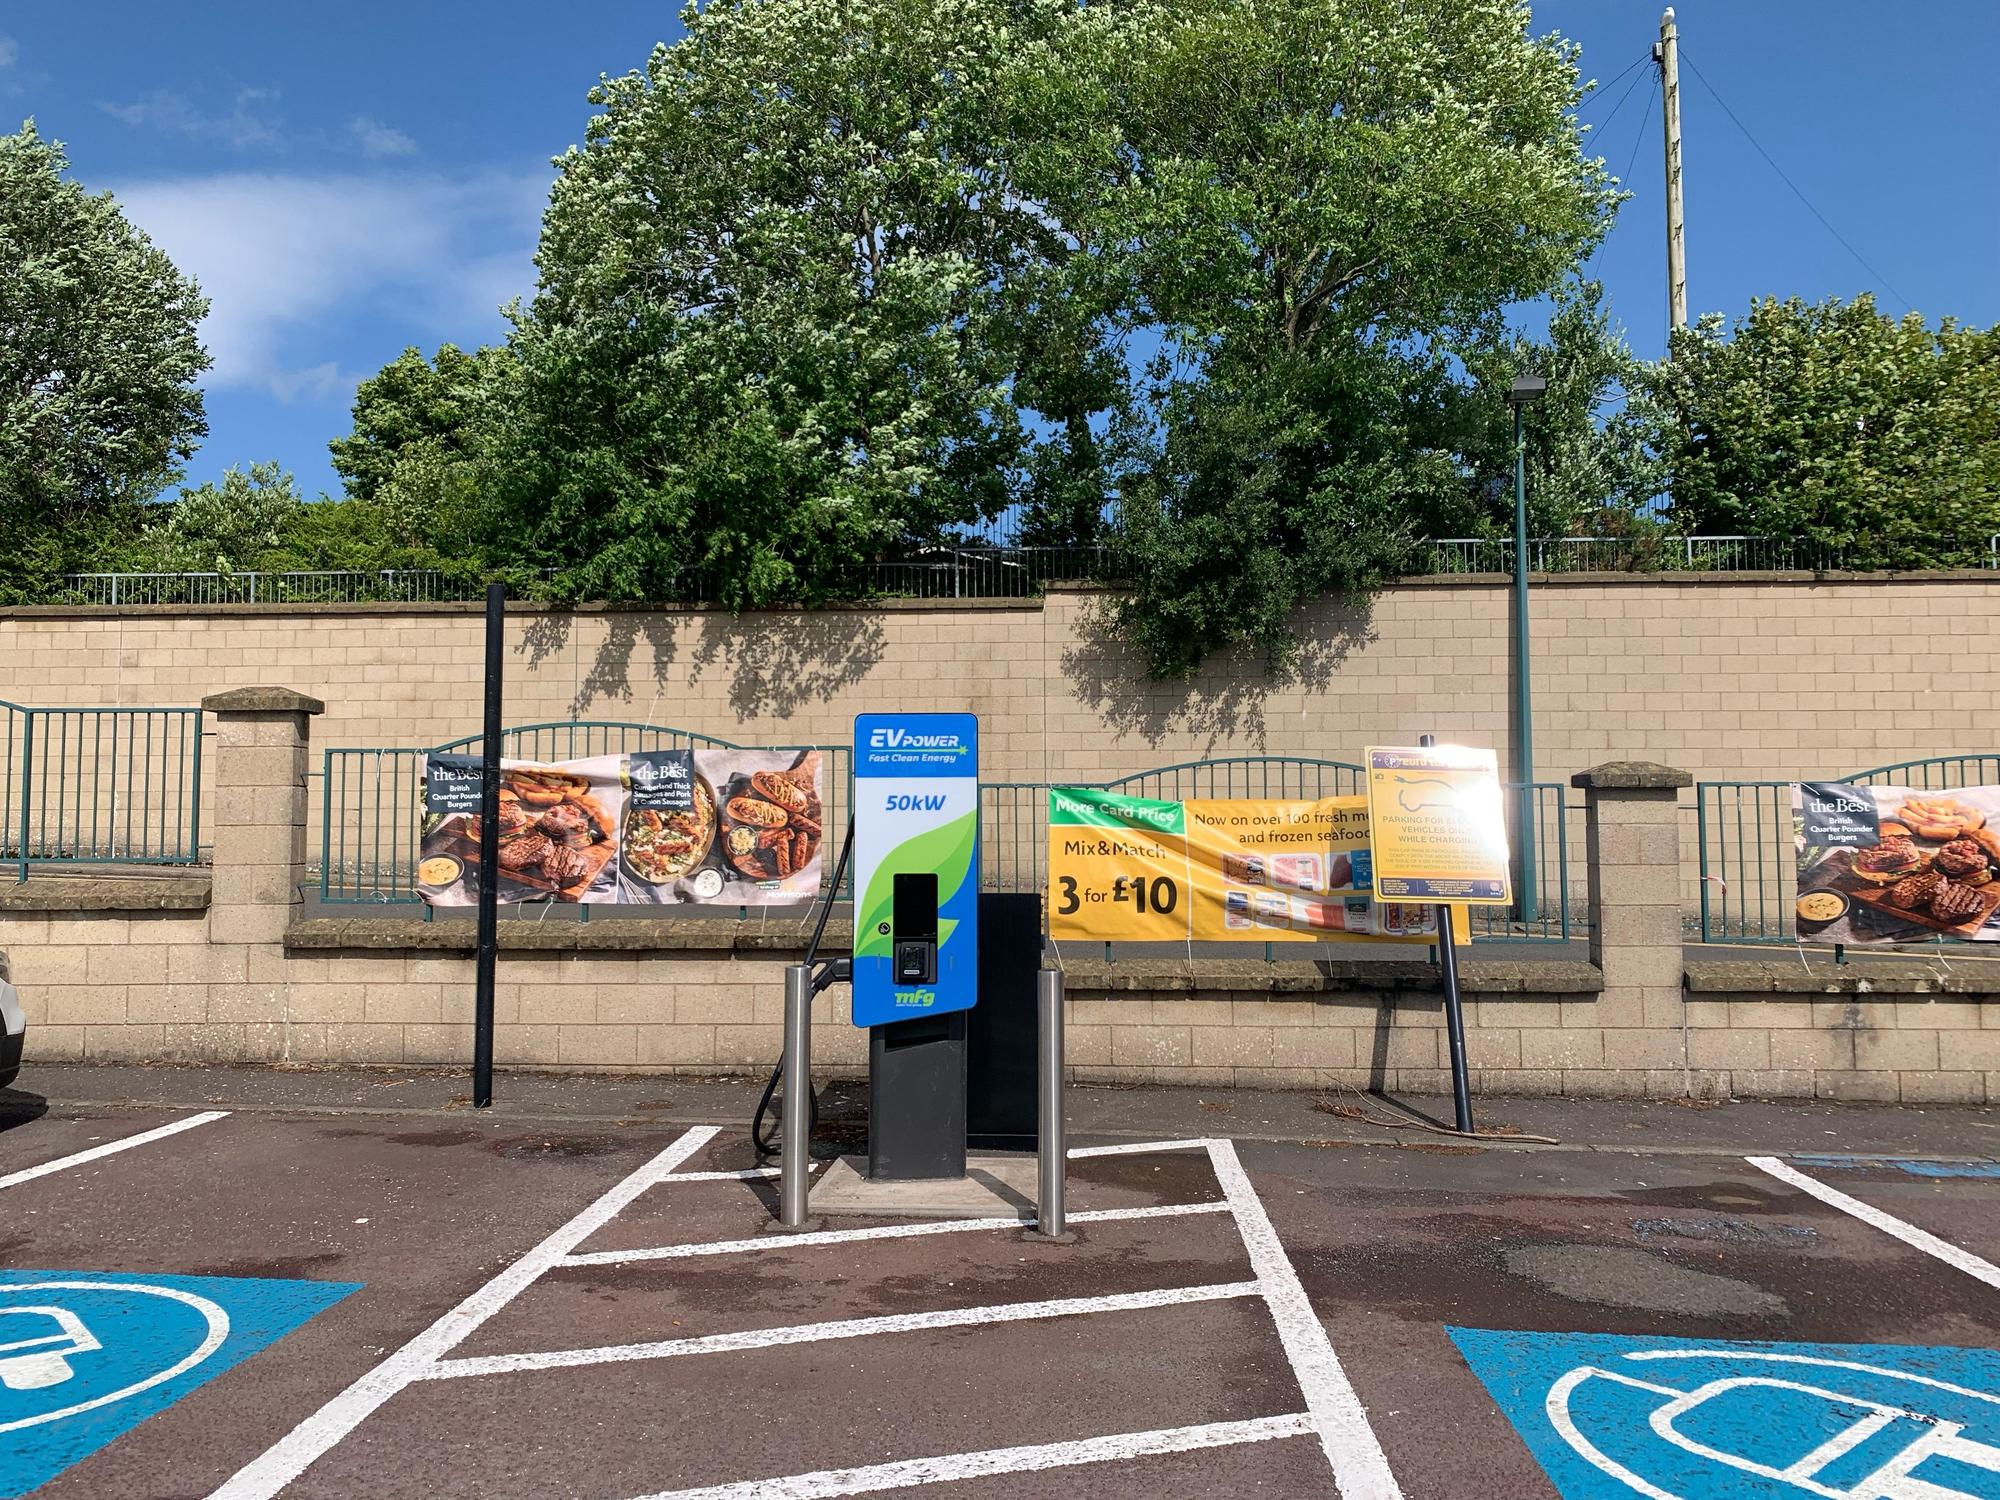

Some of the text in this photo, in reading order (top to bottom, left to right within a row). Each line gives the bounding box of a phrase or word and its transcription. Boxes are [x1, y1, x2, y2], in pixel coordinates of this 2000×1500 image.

[869, 754, 956, 763] Fast Clean Energy
[673, 782, 692, 790] Thick
[432, 793, 459, 801] Quarter
[664, 790, 675, 798] and
[676, 790, 692, 798] Pork
[447, 801, 473, 809] Burgers
[662, 798, 691, 807] Sausages
[885, 795, 947, 811] 50kW
[1056, 798, 1175, 822] More Card Price
[1195, 813, 1226, 825] Now
[1231, 816, 1248, 825] on
[1252, 816, 1281, 825] over
[1286, 813, 1309, 824] 100
[1314, 810, 1348, 823] fresh
[1382, 816, 1422, 824] PARKING
[1424, 817, 1443, 825] FOR
[1402, 826, 1445, 834] VEHICLES
[1239, 831, 1264, 843] and
[1269, 829, 1313, 842] frozen
[1828, 834, 1857, 842] Burgers
[1058, 875, 1177, 915] 3 for £10
[895, 989, 935, 1007] mfg
